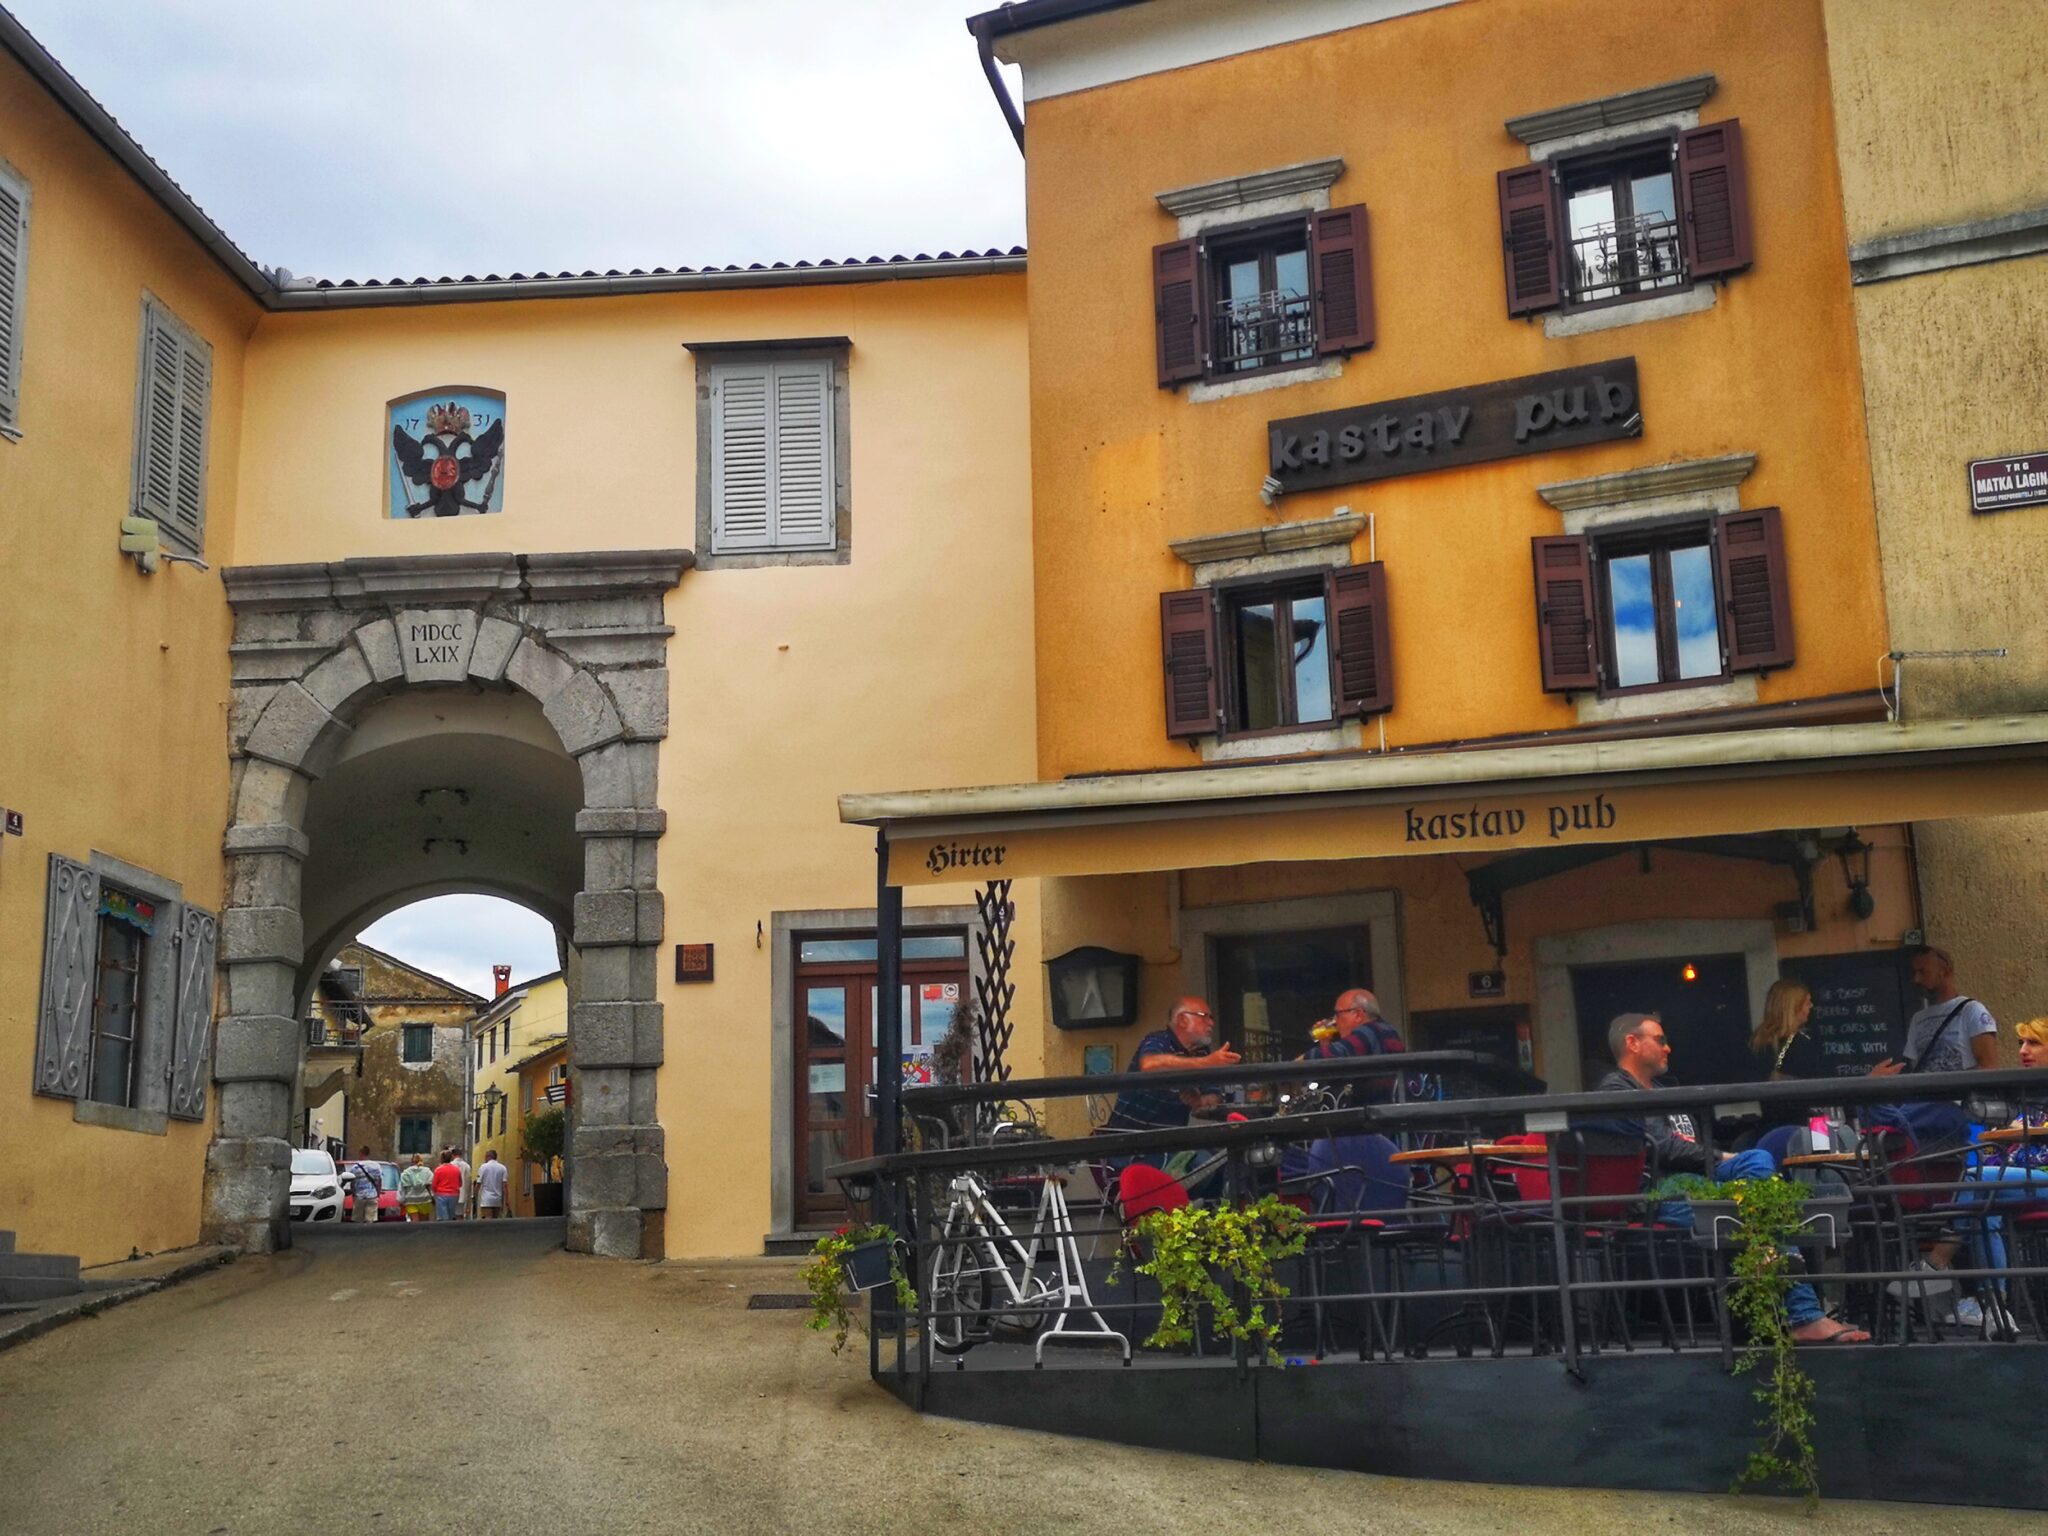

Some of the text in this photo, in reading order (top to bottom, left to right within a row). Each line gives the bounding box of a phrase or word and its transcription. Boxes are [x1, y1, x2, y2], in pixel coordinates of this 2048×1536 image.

[404, 414, 490, 431] 17 31
[1270, 376, 1634, 470] kastav pub
[2005, 462, 2030, 472] TRG
[1976, 475, 2014, 494] MATKA
[2015, 471, 2048, 488] LAGIN
[411, 623, 462, 641] MDCC
[415, 645, 460, 664] LXIX
[1405, 793, 1616, 842] kastav pub
[926, 842, 1007, 877] Hirter
[1481, 975, 1492, 988] 6
[1855, 1004, 1877, 1016] ARE
[1870, 1022, 1888, 1032] WE
[1822, 1041, 1888, 1056] DRINK WITH
[1836, 1063, 1875, 1076] FRIEND
